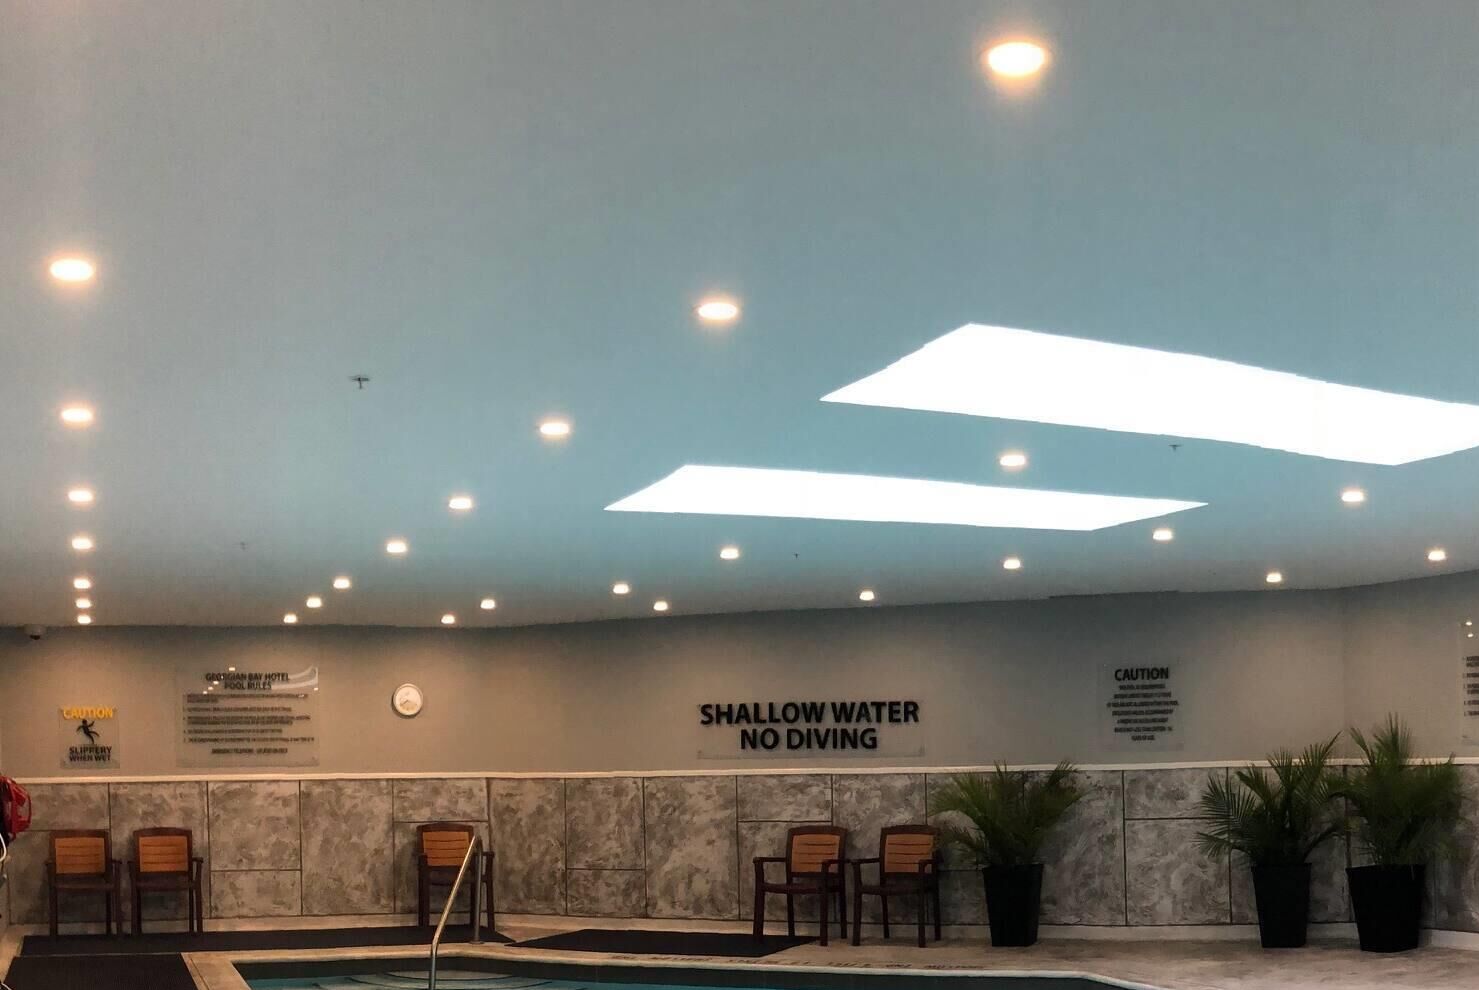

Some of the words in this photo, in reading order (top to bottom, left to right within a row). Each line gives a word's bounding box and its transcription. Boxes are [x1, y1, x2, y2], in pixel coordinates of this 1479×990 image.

[205, 672, 247, 682] GEORGIAN
[248, 672, 262, 681] BAY
[264, 672, 289, 681] HOTEL
[1114, 667, 1169, 681] CAUTION
[224, 681, 246, 690] POOL
[247, 681, 272, 690] RULES
[63, 707, 114, 720] CAUTION
[700, 702, 825, 725] SHALLOW
[831, 701, 919, 723] WATER
[740, 728, 779, 750] NO
[786, 727, 878, 750] DIVING
[69, 746, 112, 754] SLIPPERY
[69, 753, 93, 762] WHEN
[94, 753, 111, 762] WET
